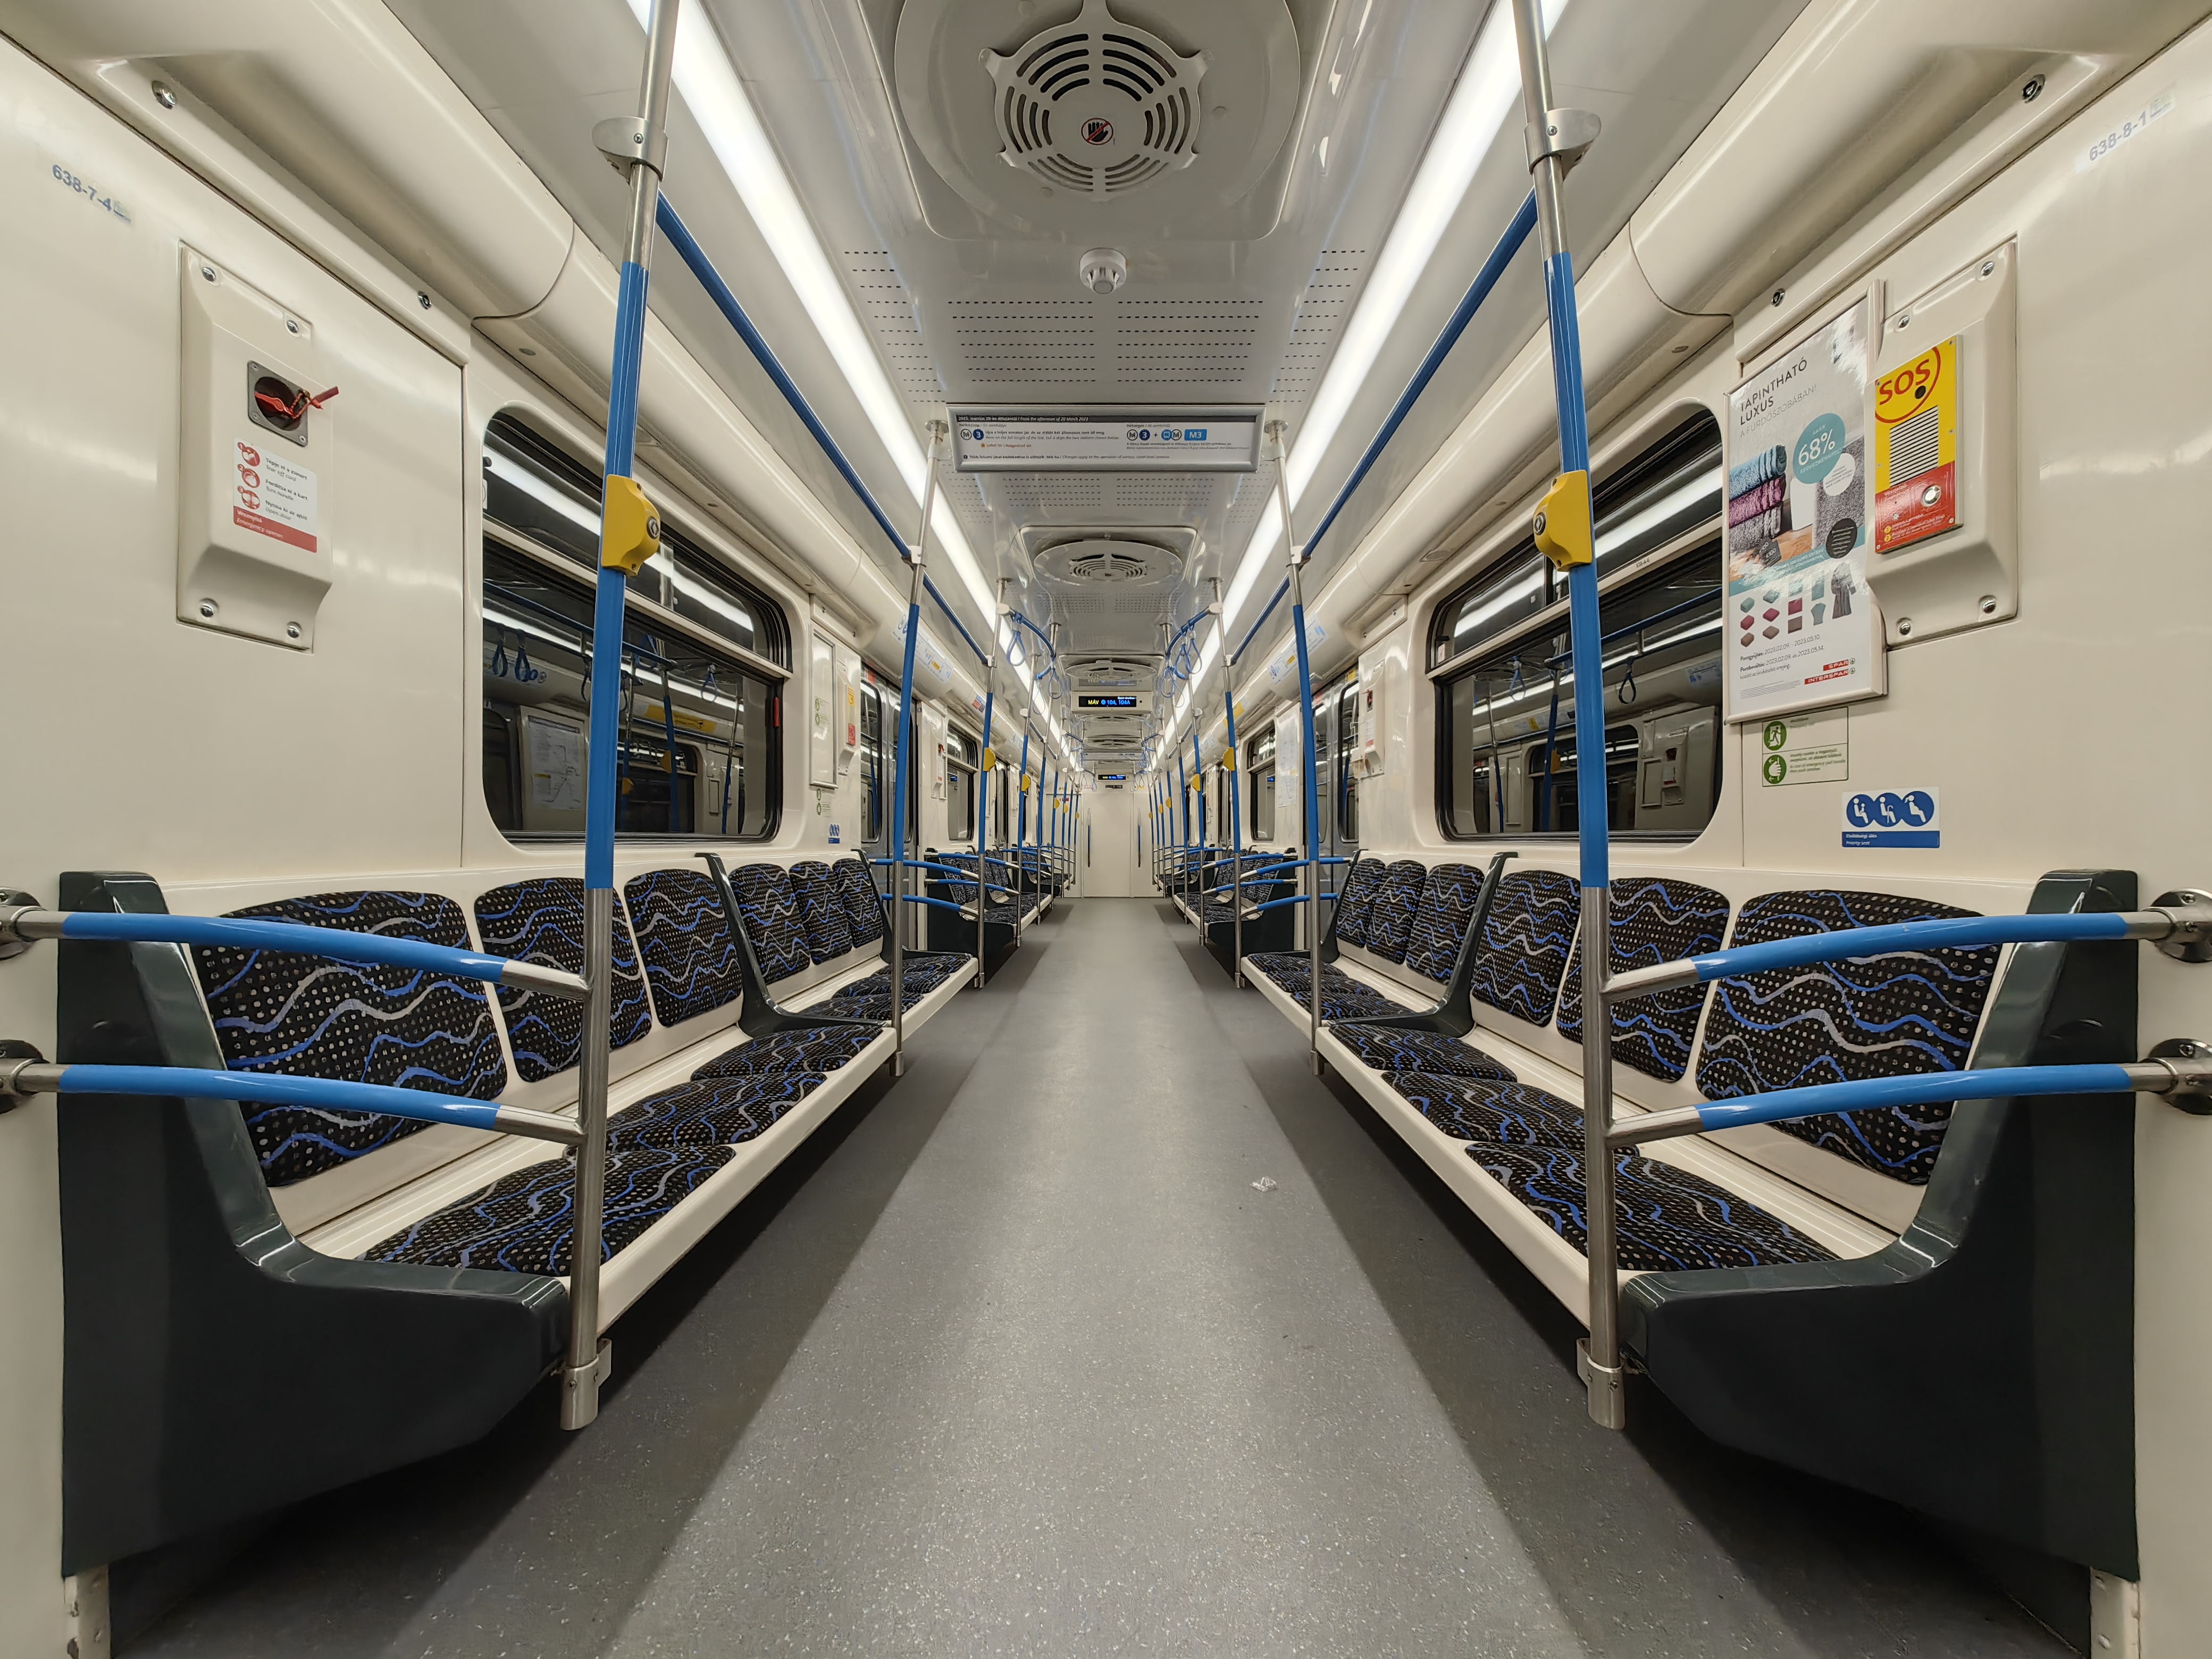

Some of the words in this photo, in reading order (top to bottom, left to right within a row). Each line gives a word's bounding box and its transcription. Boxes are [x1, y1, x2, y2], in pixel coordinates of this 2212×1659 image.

[2089, 110, 2146, 161] 638-8-1
[52, 164, 112, 212] 638-7-4
[1740, 357, 1807, 412] TAPINTHATÓ
[1879, 358, 1931, 405] SOS
[1740, 396, 1774, 426] LUXUS
[1798, 428, 1835, 465] 68%
[1808, 670, 1849, 683] INTERSPAR
[1829, 660, 1849, 669] SPAR
